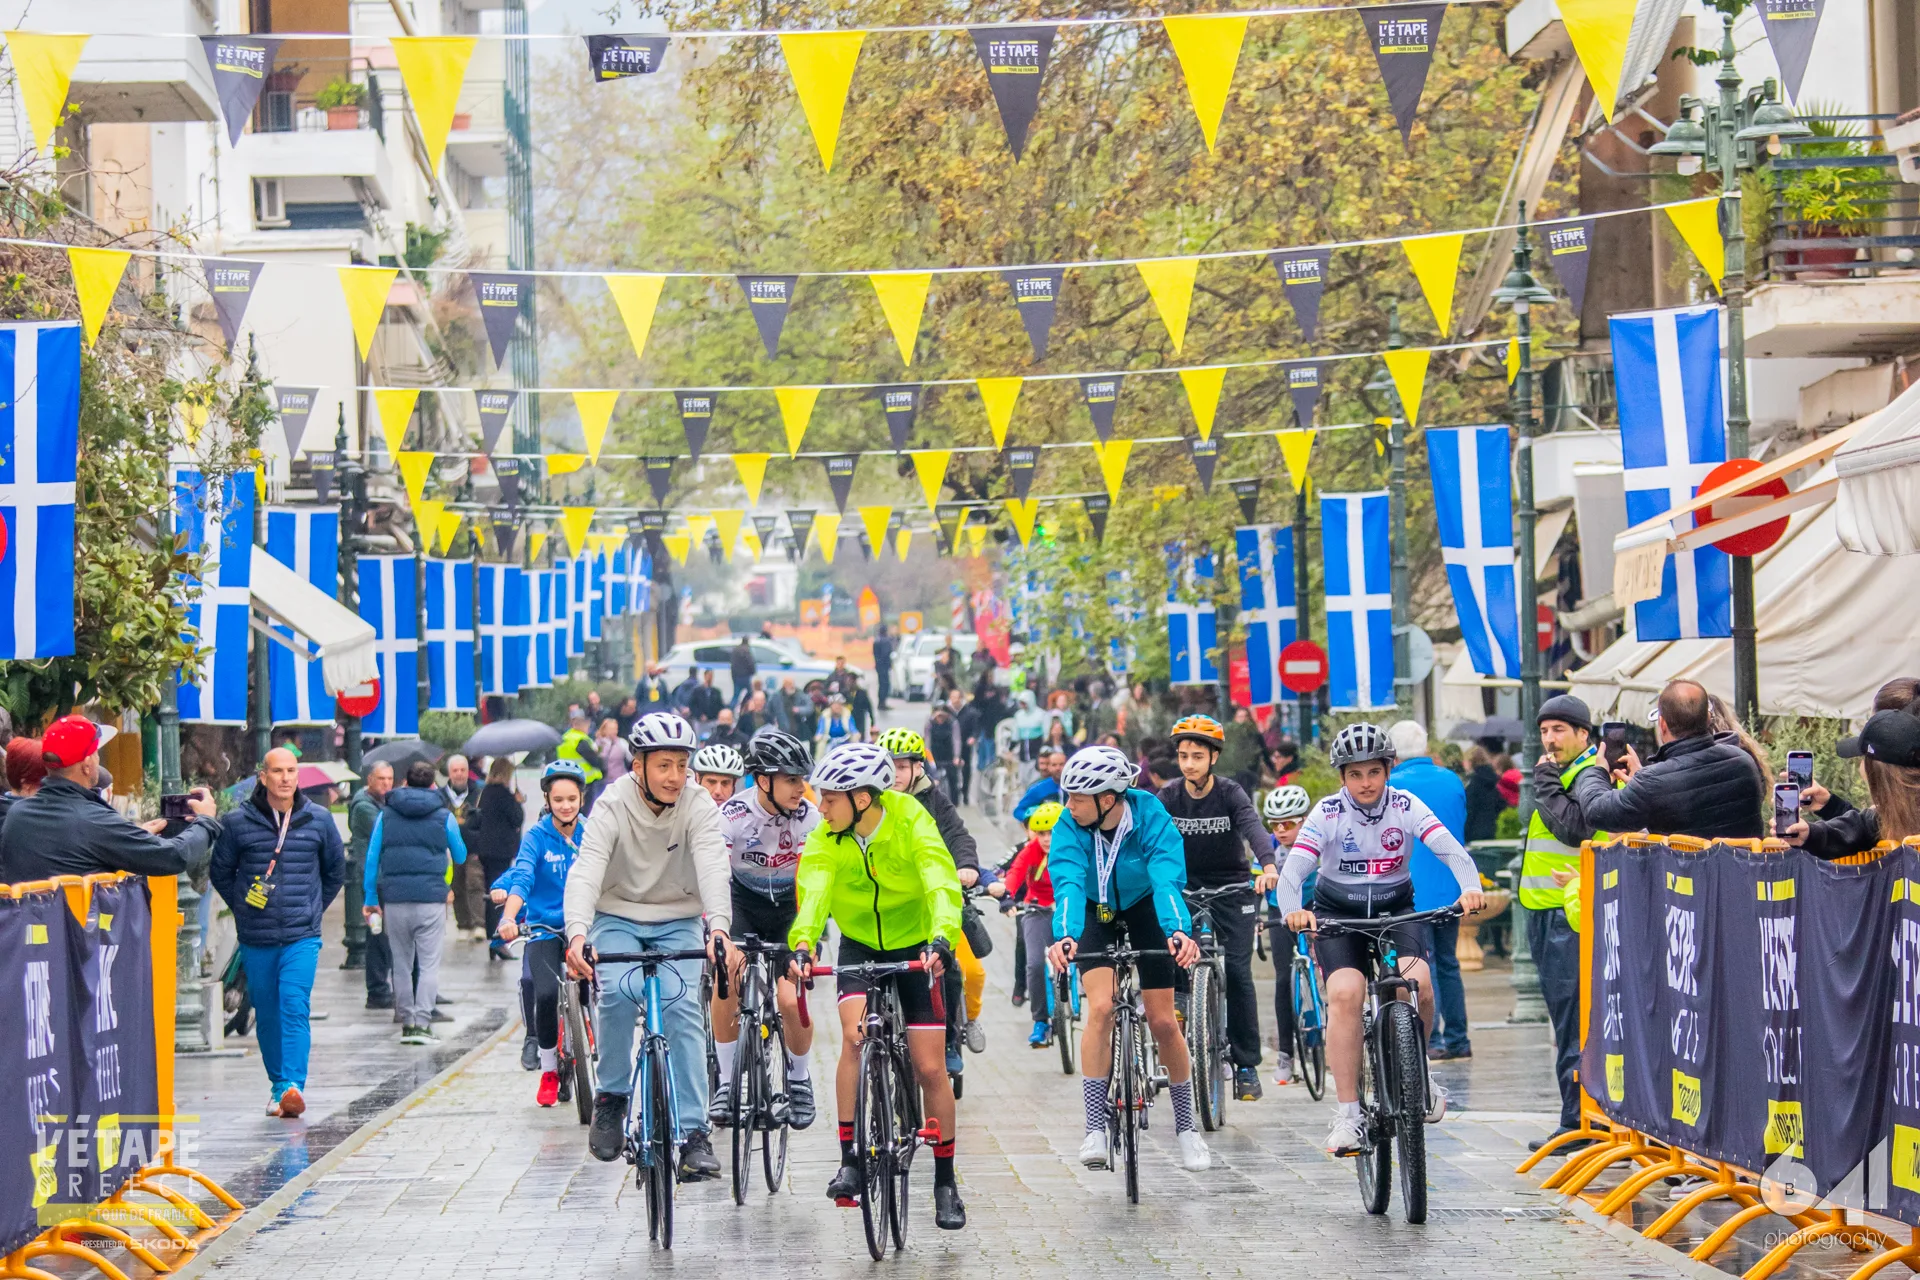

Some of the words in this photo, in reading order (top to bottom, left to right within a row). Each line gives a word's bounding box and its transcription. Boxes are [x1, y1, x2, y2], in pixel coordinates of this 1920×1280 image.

[1767, 3, 1816, 12] GREECE
[1379, 36, 1428, 45] GREECE
[990, 57, 1038, 66] GREECE
[602, 62, 651, 73] GREECE
[1348, 892, 1367, 901] elite
[1373, 890, 1396, 900] strom
